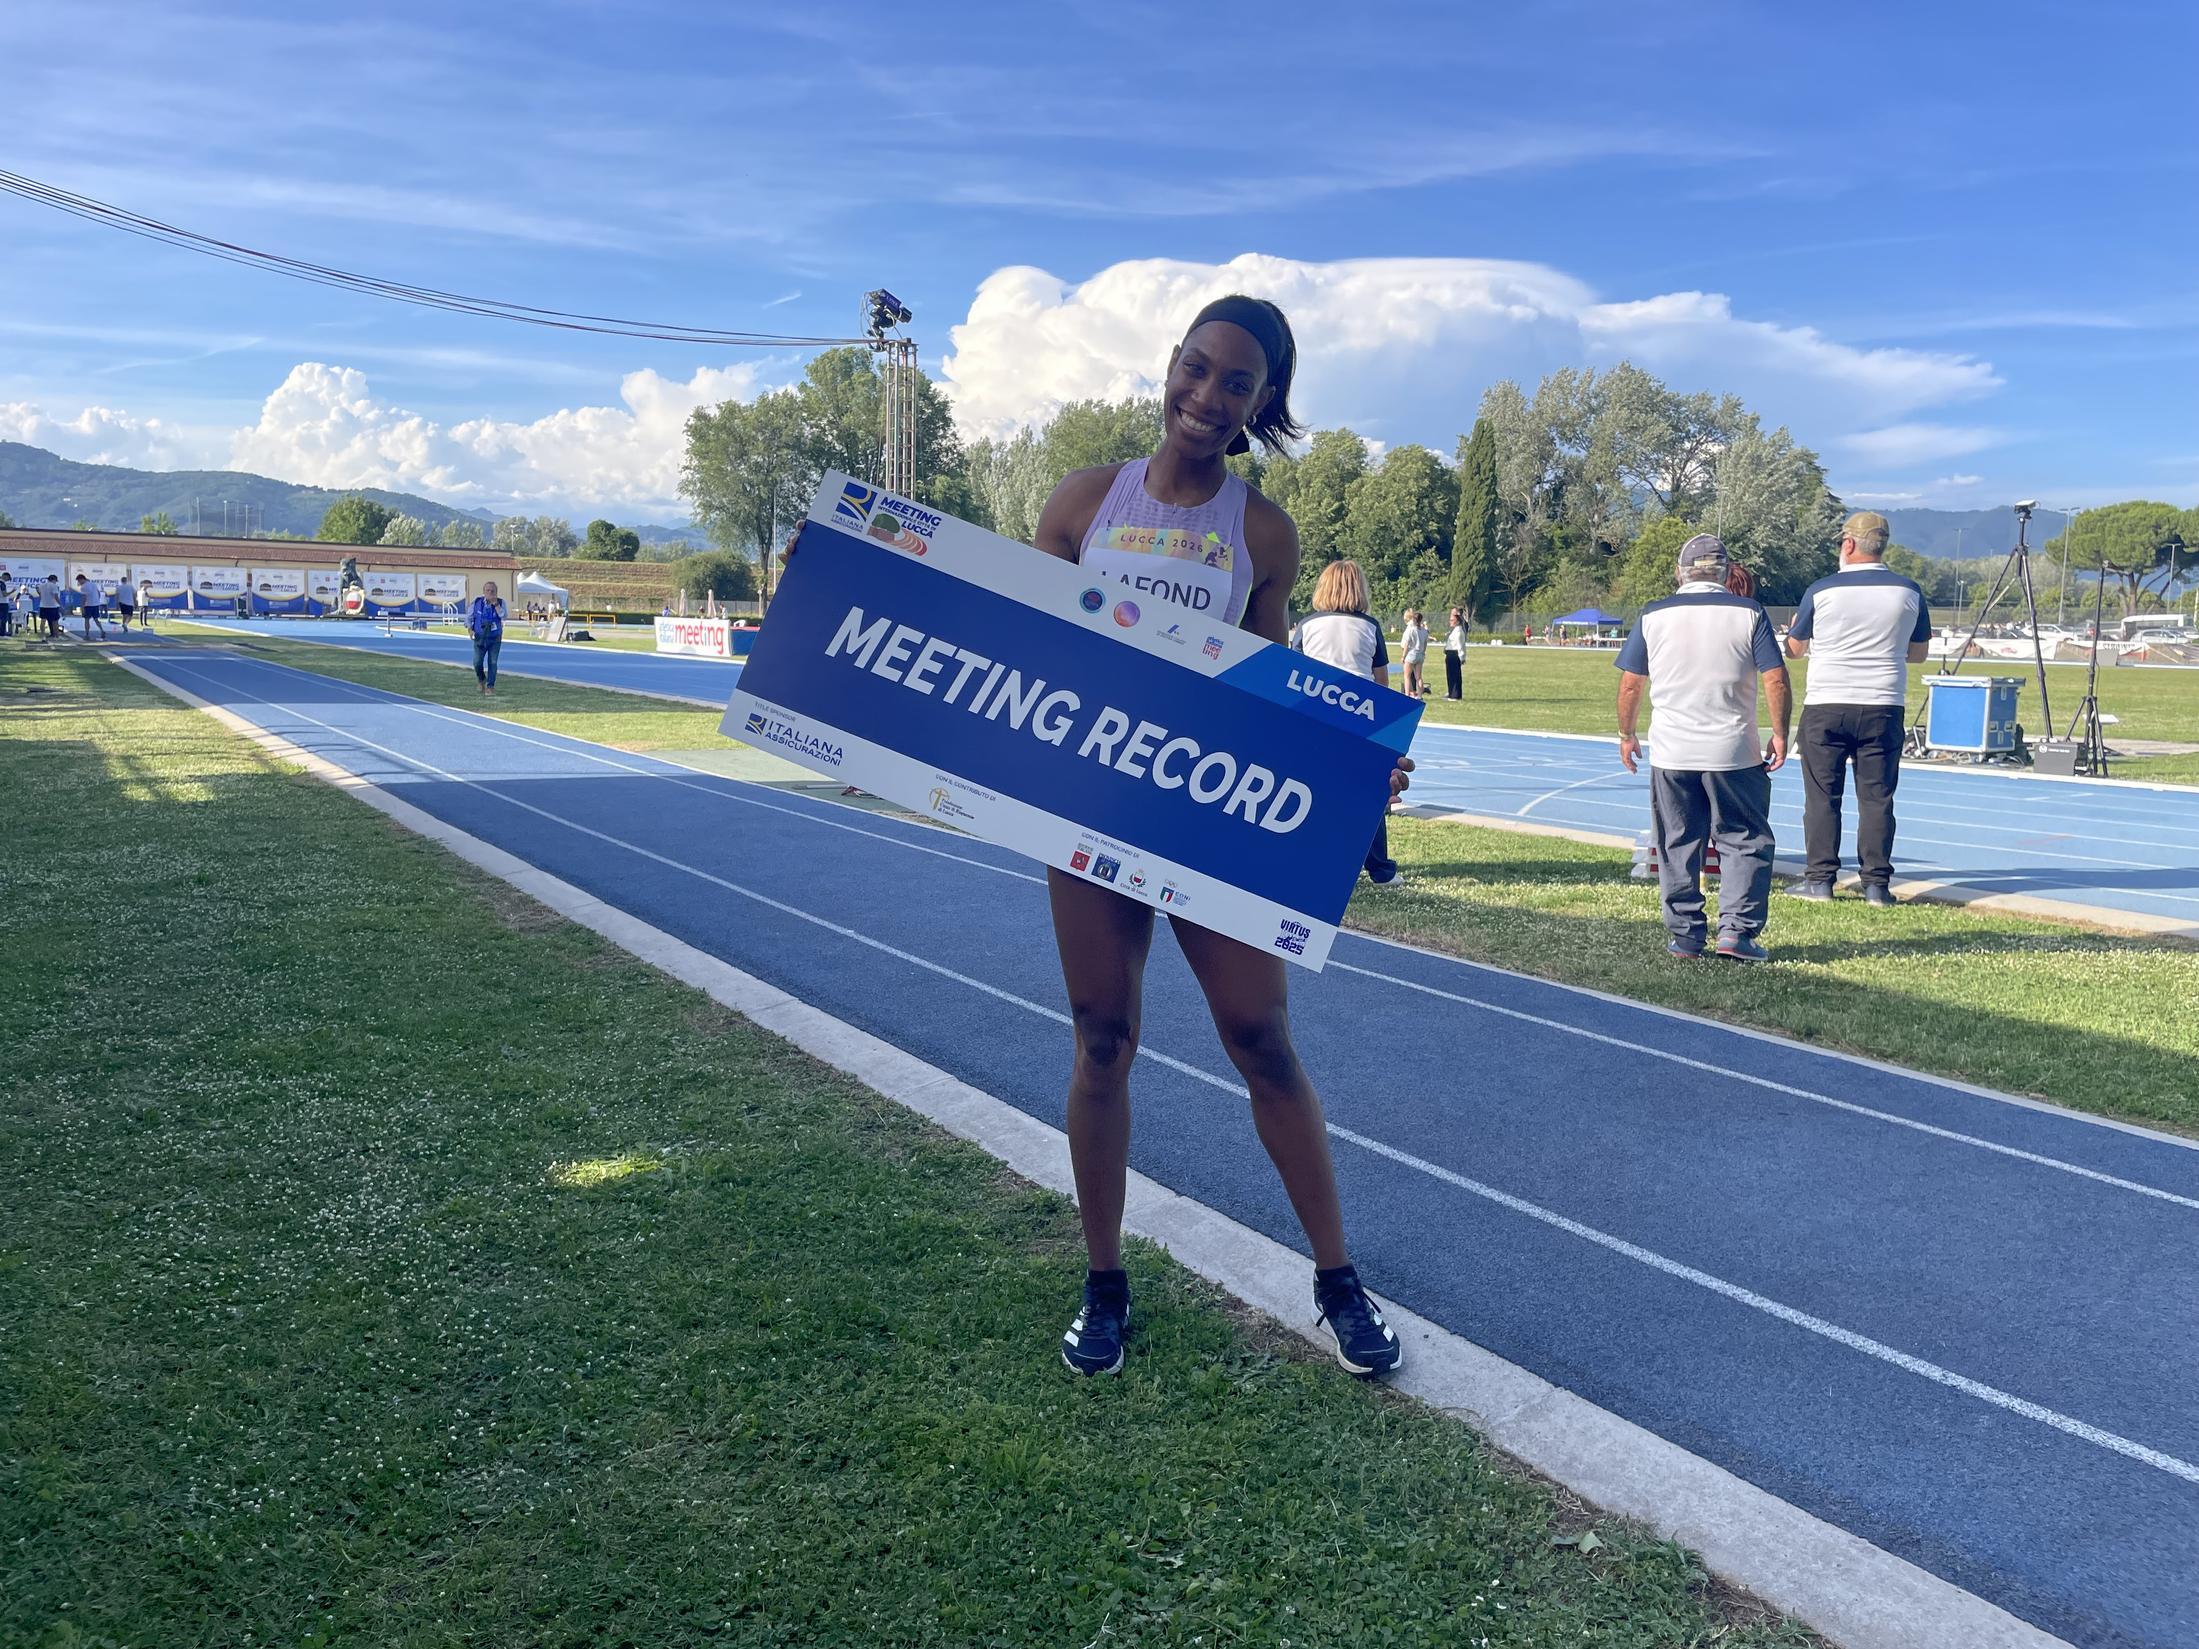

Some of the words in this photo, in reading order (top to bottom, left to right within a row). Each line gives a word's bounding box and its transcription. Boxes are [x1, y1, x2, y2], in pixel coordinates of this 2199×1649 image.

[832, 513, 864, 530] ITALIANA
[881, 496, 942, 527] MEETING
[901, 520, 933, 539] LUCCA
[1120, 534, 1165, 546] LUCCA
[1172, 538, 1204, 553] 2026
[1102, 570, 1212, 611] FOND
[674, 620, 725, 656] meeting
[1286, 669, 1376, 721] LUCCA
[769, 708, 797, 722] SPONSOR
[823, 604, 1081, 747] MEETING
[1077, 705, 1313, 834] RECORD
[764, 732, 842, 767] ASSICURAZIONI
[768, 720, 844, 759] ITALIANA
[954, 781, 990, 799] CONTRIBUTO
[1081, 832, 1095, 842] CON
[1099, 839, 1133, 856] PATROCINIO
[1280, 918, 1311, 939] VIRTUS
[1274, 936, 1305, 956] 2025
